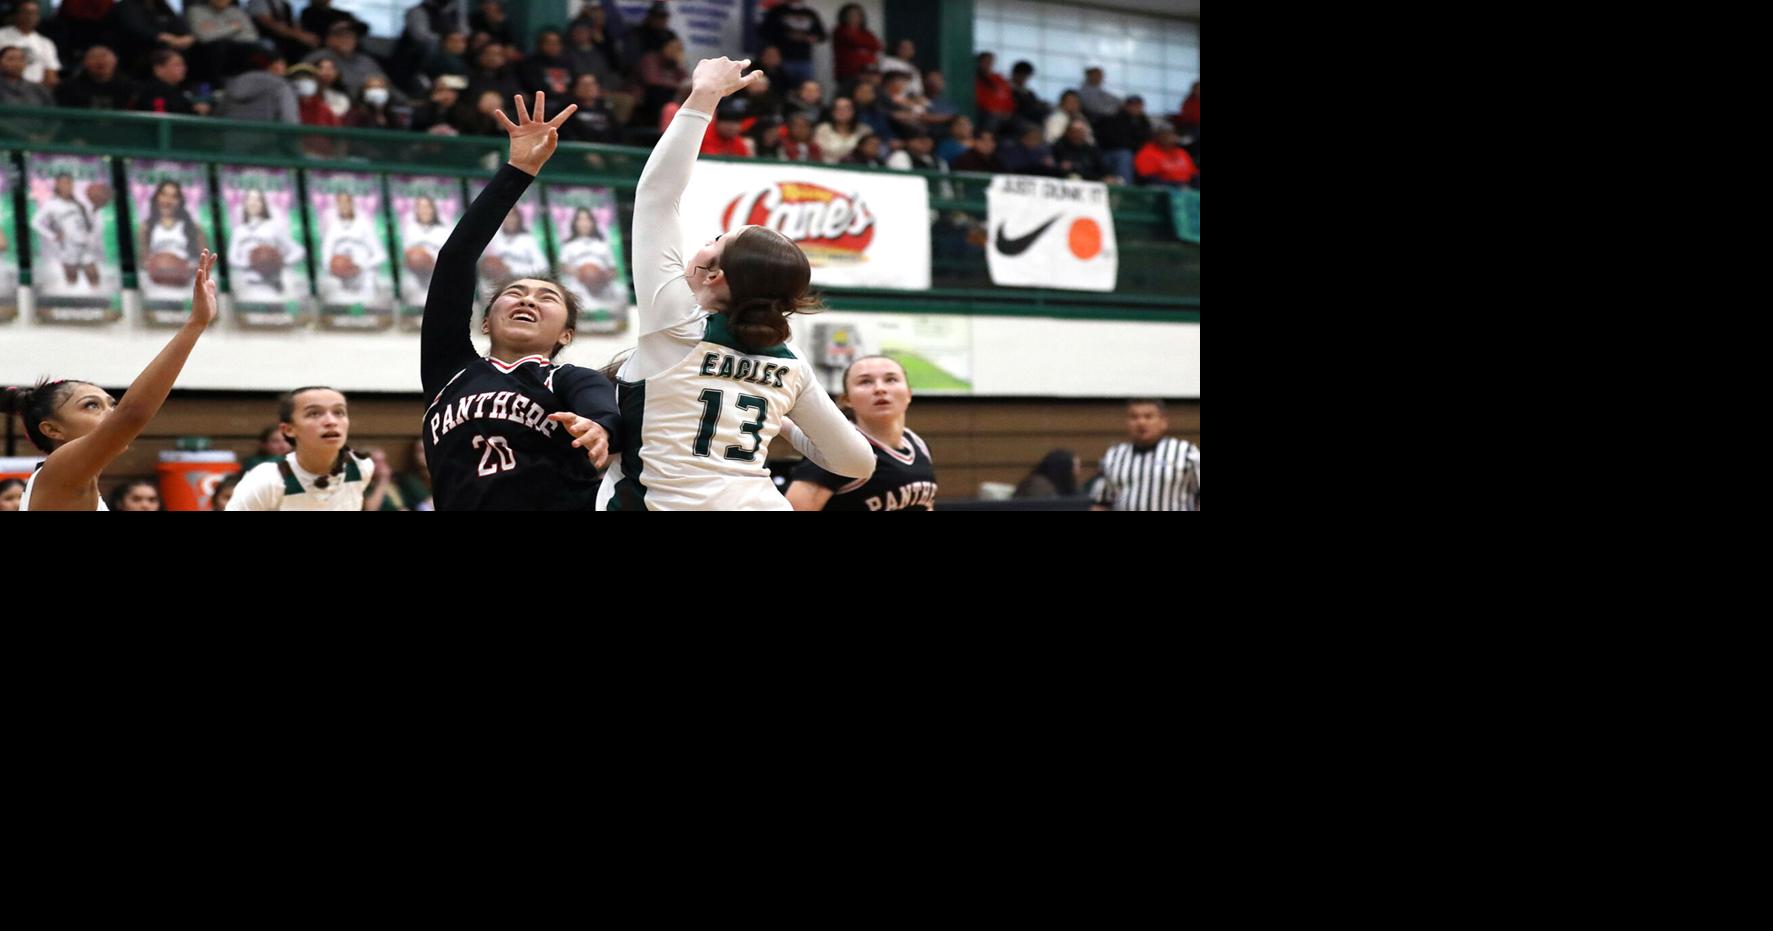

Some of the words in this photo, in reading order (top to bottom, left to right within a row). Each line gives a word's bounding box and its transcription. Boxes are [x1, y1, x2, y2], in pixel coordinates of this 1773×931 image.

[699, 351, 790, 388] EAGLES
[692, 387, 769, 461] 13
[472, 434, 517, 478] 20
